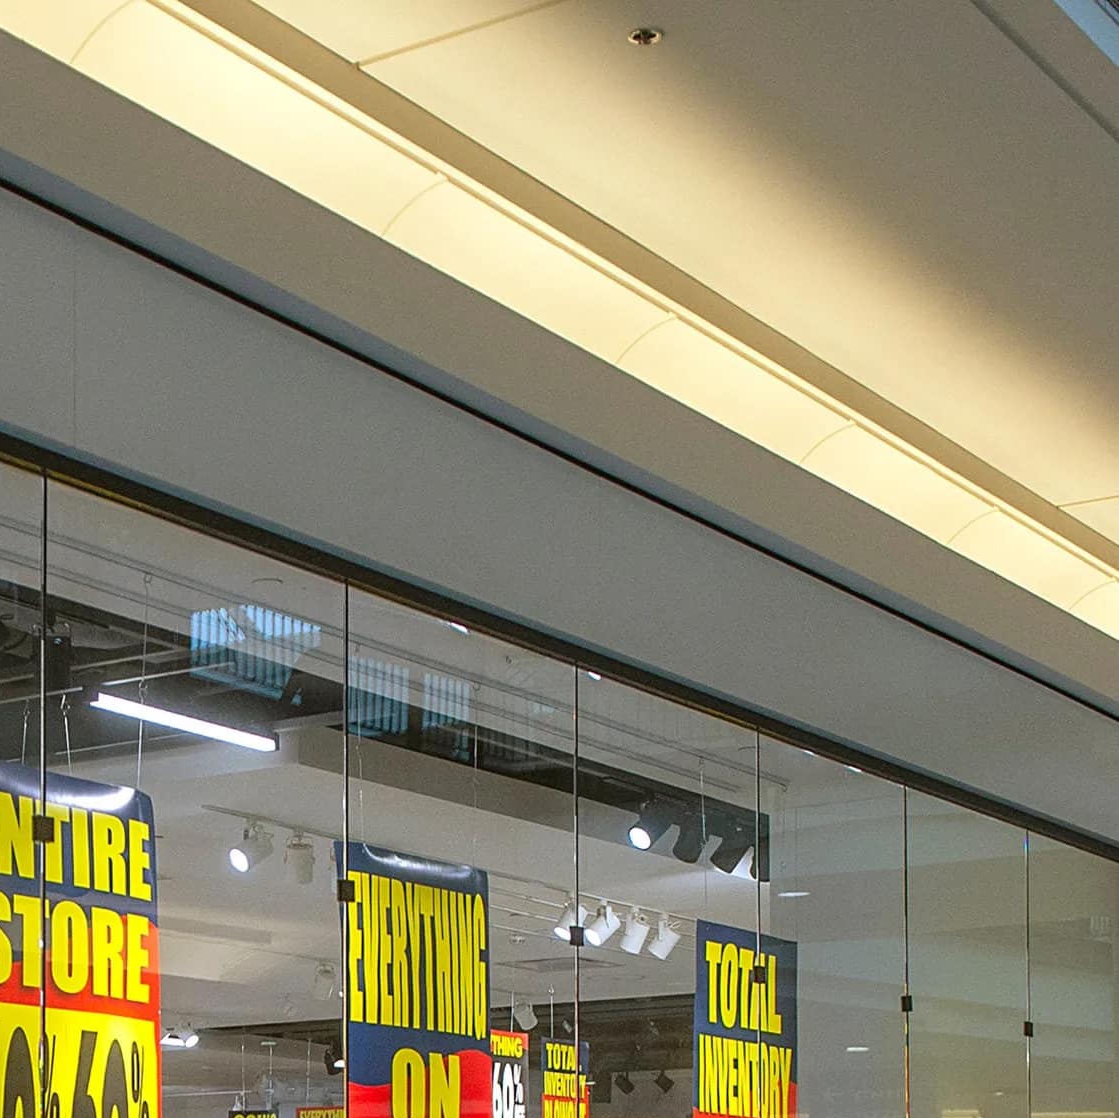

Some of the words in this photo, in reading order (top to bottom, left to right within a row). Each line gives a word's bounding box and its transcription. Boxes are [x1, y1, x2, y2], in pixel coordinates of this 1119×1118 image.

[348, 870, 487, 1041] EVERYTHING
[705, 940, 782, 1035] TOTAL
[544, 1071, 586, 1099] INVENTOY
[545, 1042, 582, 1073] TOTA
